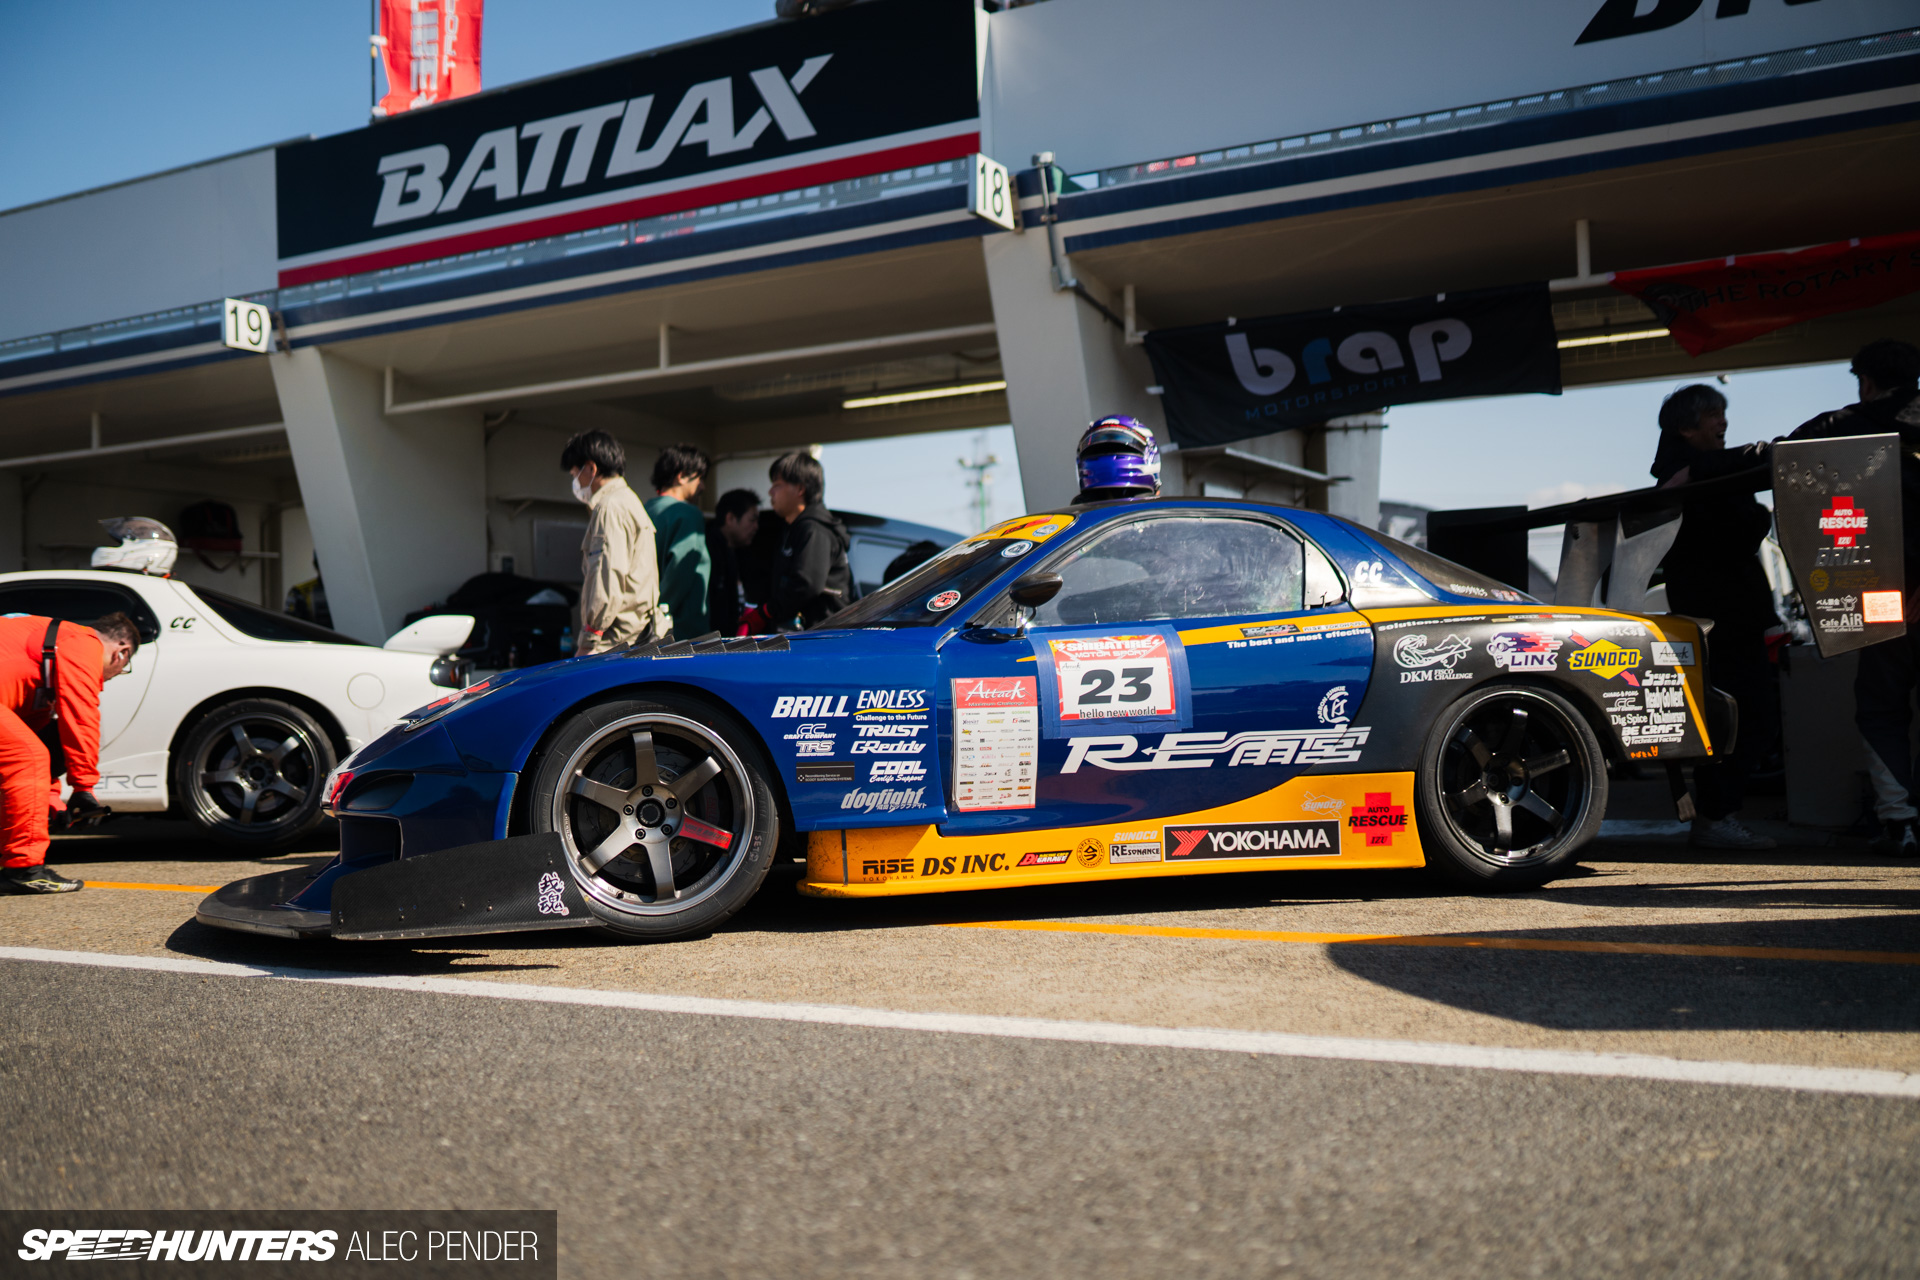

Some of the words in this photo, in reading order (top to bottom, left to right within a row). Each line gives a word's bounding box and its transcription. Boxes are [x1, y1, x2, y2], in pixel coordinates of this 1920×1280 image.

[372, 53, 834, 227] BATTLAX
[980, 163, 1004, 218] 18
[1758, 256, 1897, 300] ROTARY
[229, 305, 264, 346] 19
[1225, 317, 1473, 396] brap
[1245, 373, 1410, 422] MOTORSPORT
[1819, 516, 1868, 529] RESCUE
[1354, 560, 1383, 583] CC
[170, 617, 196, 629] CC
[1227, 641, 1247, 649] The
[1249, 638, 1272, 647] best
[1275, 635, 1294, 644] and
[1296, 633, 1322, 642] most
[1325, 627, 1371, 639] effective
[1112, 649, 1148, 657] SPORT
[1573, 651, 1638, 668] SUNOCO
[1511, 654, 1556, 667] LINK
[1400, 670, 1433, 684] DKM
[1434, 673, 1473, 681] CHALLENGE
[965, 680, 1026, 701] Attack
[1078, 667, 1154, 705] 23
[856, 690, 926, 709] ENDLESS
[771, 696, 849, 718] BRILL
[1079, 708, 1104, 719] hello
[1106, 709, 1127, 718] new
[1128, 706, 1156, 716] world
[852, 725, 929, 737] TRUST
[796, 740, 835, 753] TRS
[850, 741, 927, 754] GReddy
[870, 761, 927, 775] COOL
[895, 774, 924, 783] Support
[840, 786, 927, 815] dogfight
[1304, 799, 1344, 811] SUNOCO
[1348, 814, 1408, 827] RESCUE
[1113, 831, 1158, 842] SUNOCO
[1208, 828, 1331, 852] YOKOHAMA
[1371, 836, 1388, 845] IZU
[921, 856, 957, 877] DS
[961, 853, 1010, 874] INC.
[862, 874, 915, 882] YOKOHAMA
